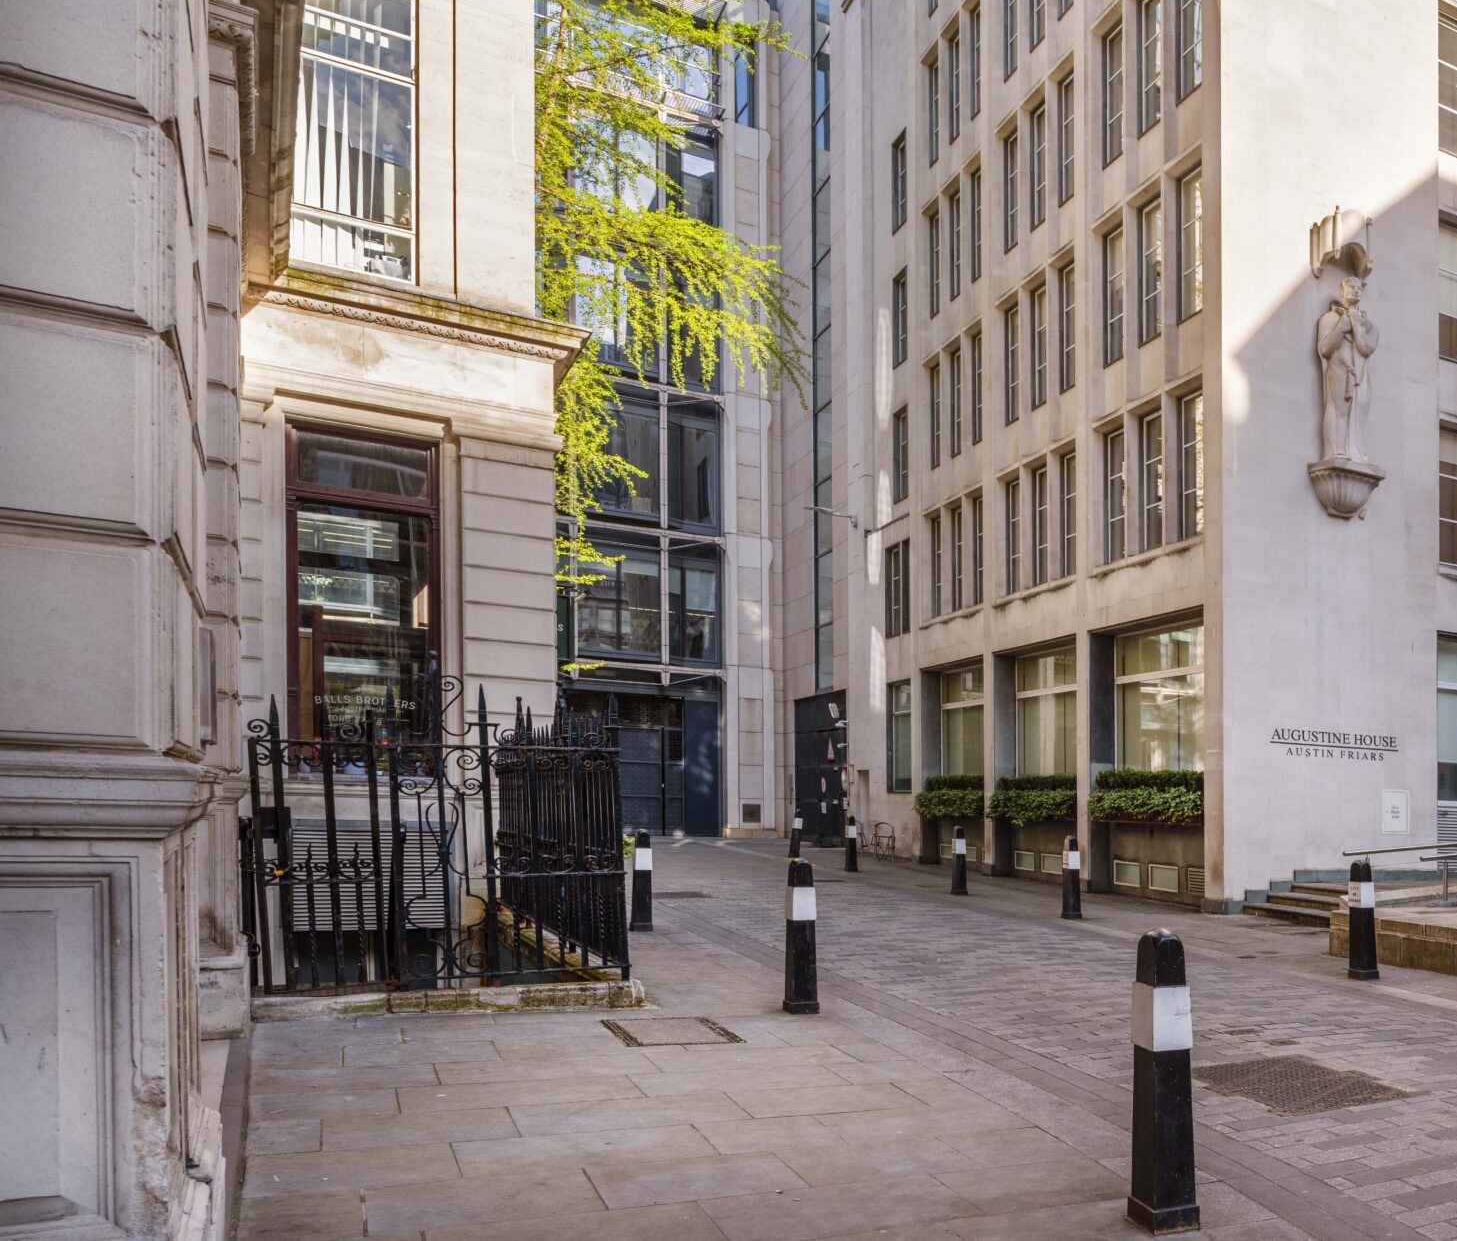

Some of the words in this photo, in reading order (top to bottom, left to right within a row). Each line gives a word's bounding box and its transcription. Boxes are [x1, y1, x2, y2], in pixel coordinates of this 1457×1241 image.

[314, 695, 351, 705] BALLS
[356, 695, 416, 710] BROTERS
[1271, 728, 1351, 745] AUGUSTINE
[1354, 734, 1397, 748] HOUSE
[1286, 747, 1334, 758] AUSTIN
[1340, 750, 1384, 761] FRIARS
